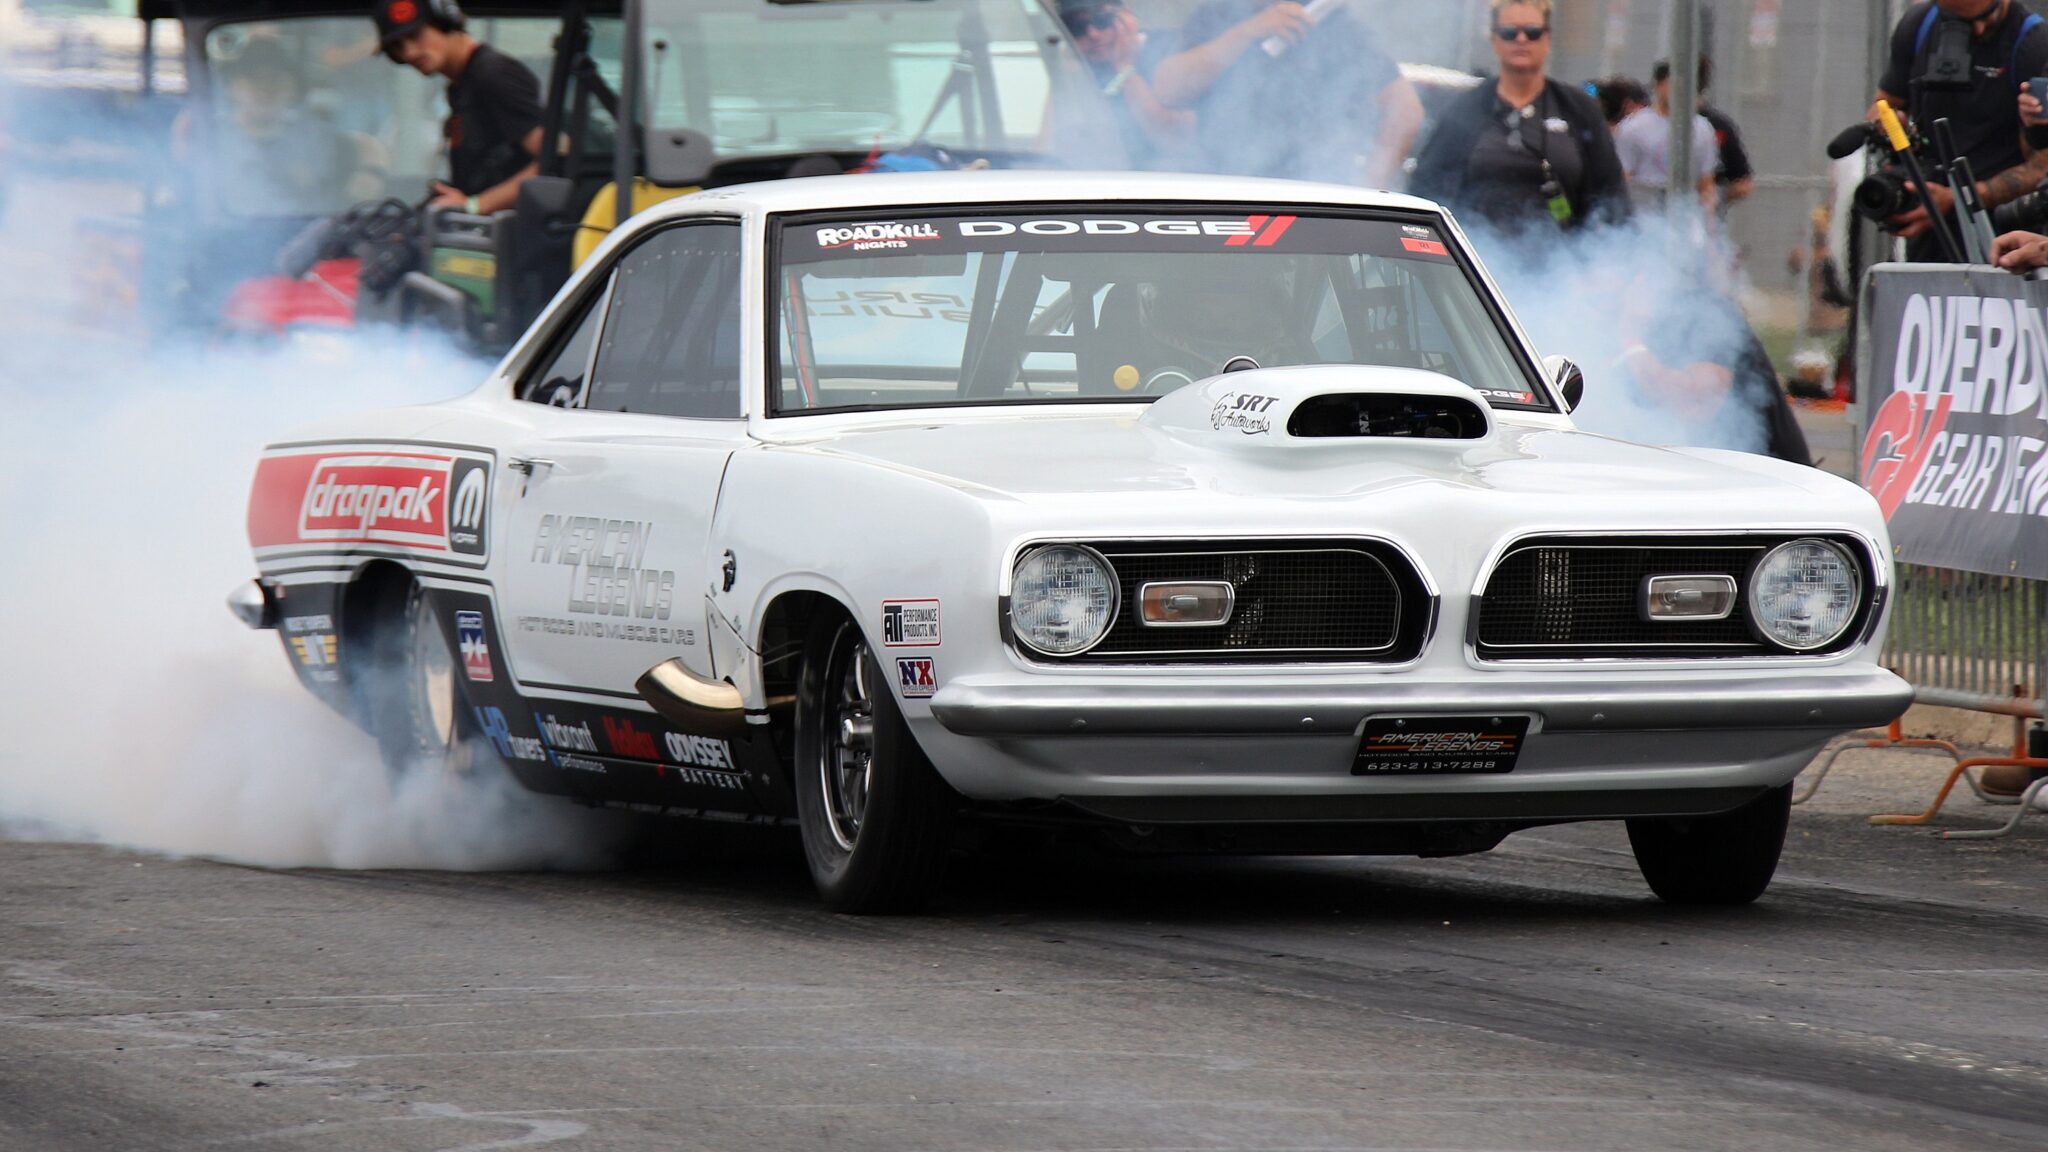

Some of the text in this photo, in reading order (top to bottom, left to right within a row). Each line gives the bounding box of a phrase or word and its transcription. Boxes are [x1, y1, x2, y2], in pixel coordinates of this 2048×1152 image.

[958, 220, 1255, 236] DODGE
[853, 240, 908, 251] NIGHTS
[1231, 394, 1280, 412] SRT
[1905, 431, 2005, 510] GEAR
[309, 473, 441, 530] dragpak
[531, 514, 652, 570] AMERICAN
[568, 564, 675, 621] LEGENDS
[884, 605, 904, 643] ATI
[903, 608, 937, 622] PERFORMANCE
[577, 621, 604, 638] AND
[605, 624, 659, 643] MUSCLE
[660, 627, 696, 646] CARS
[904, 623, 937, 638] PRODUCTS INC
[899, 661, 934, 686] NX
[475, 706, 513, 758] HP
[1379, 732, 1483, 744] AMERICAN
[664, 731, 735, 770] ODYSSEY
[1408, 741, 1505, 752] LEGENDS
[680, 768, 744, 791] BATTERY
